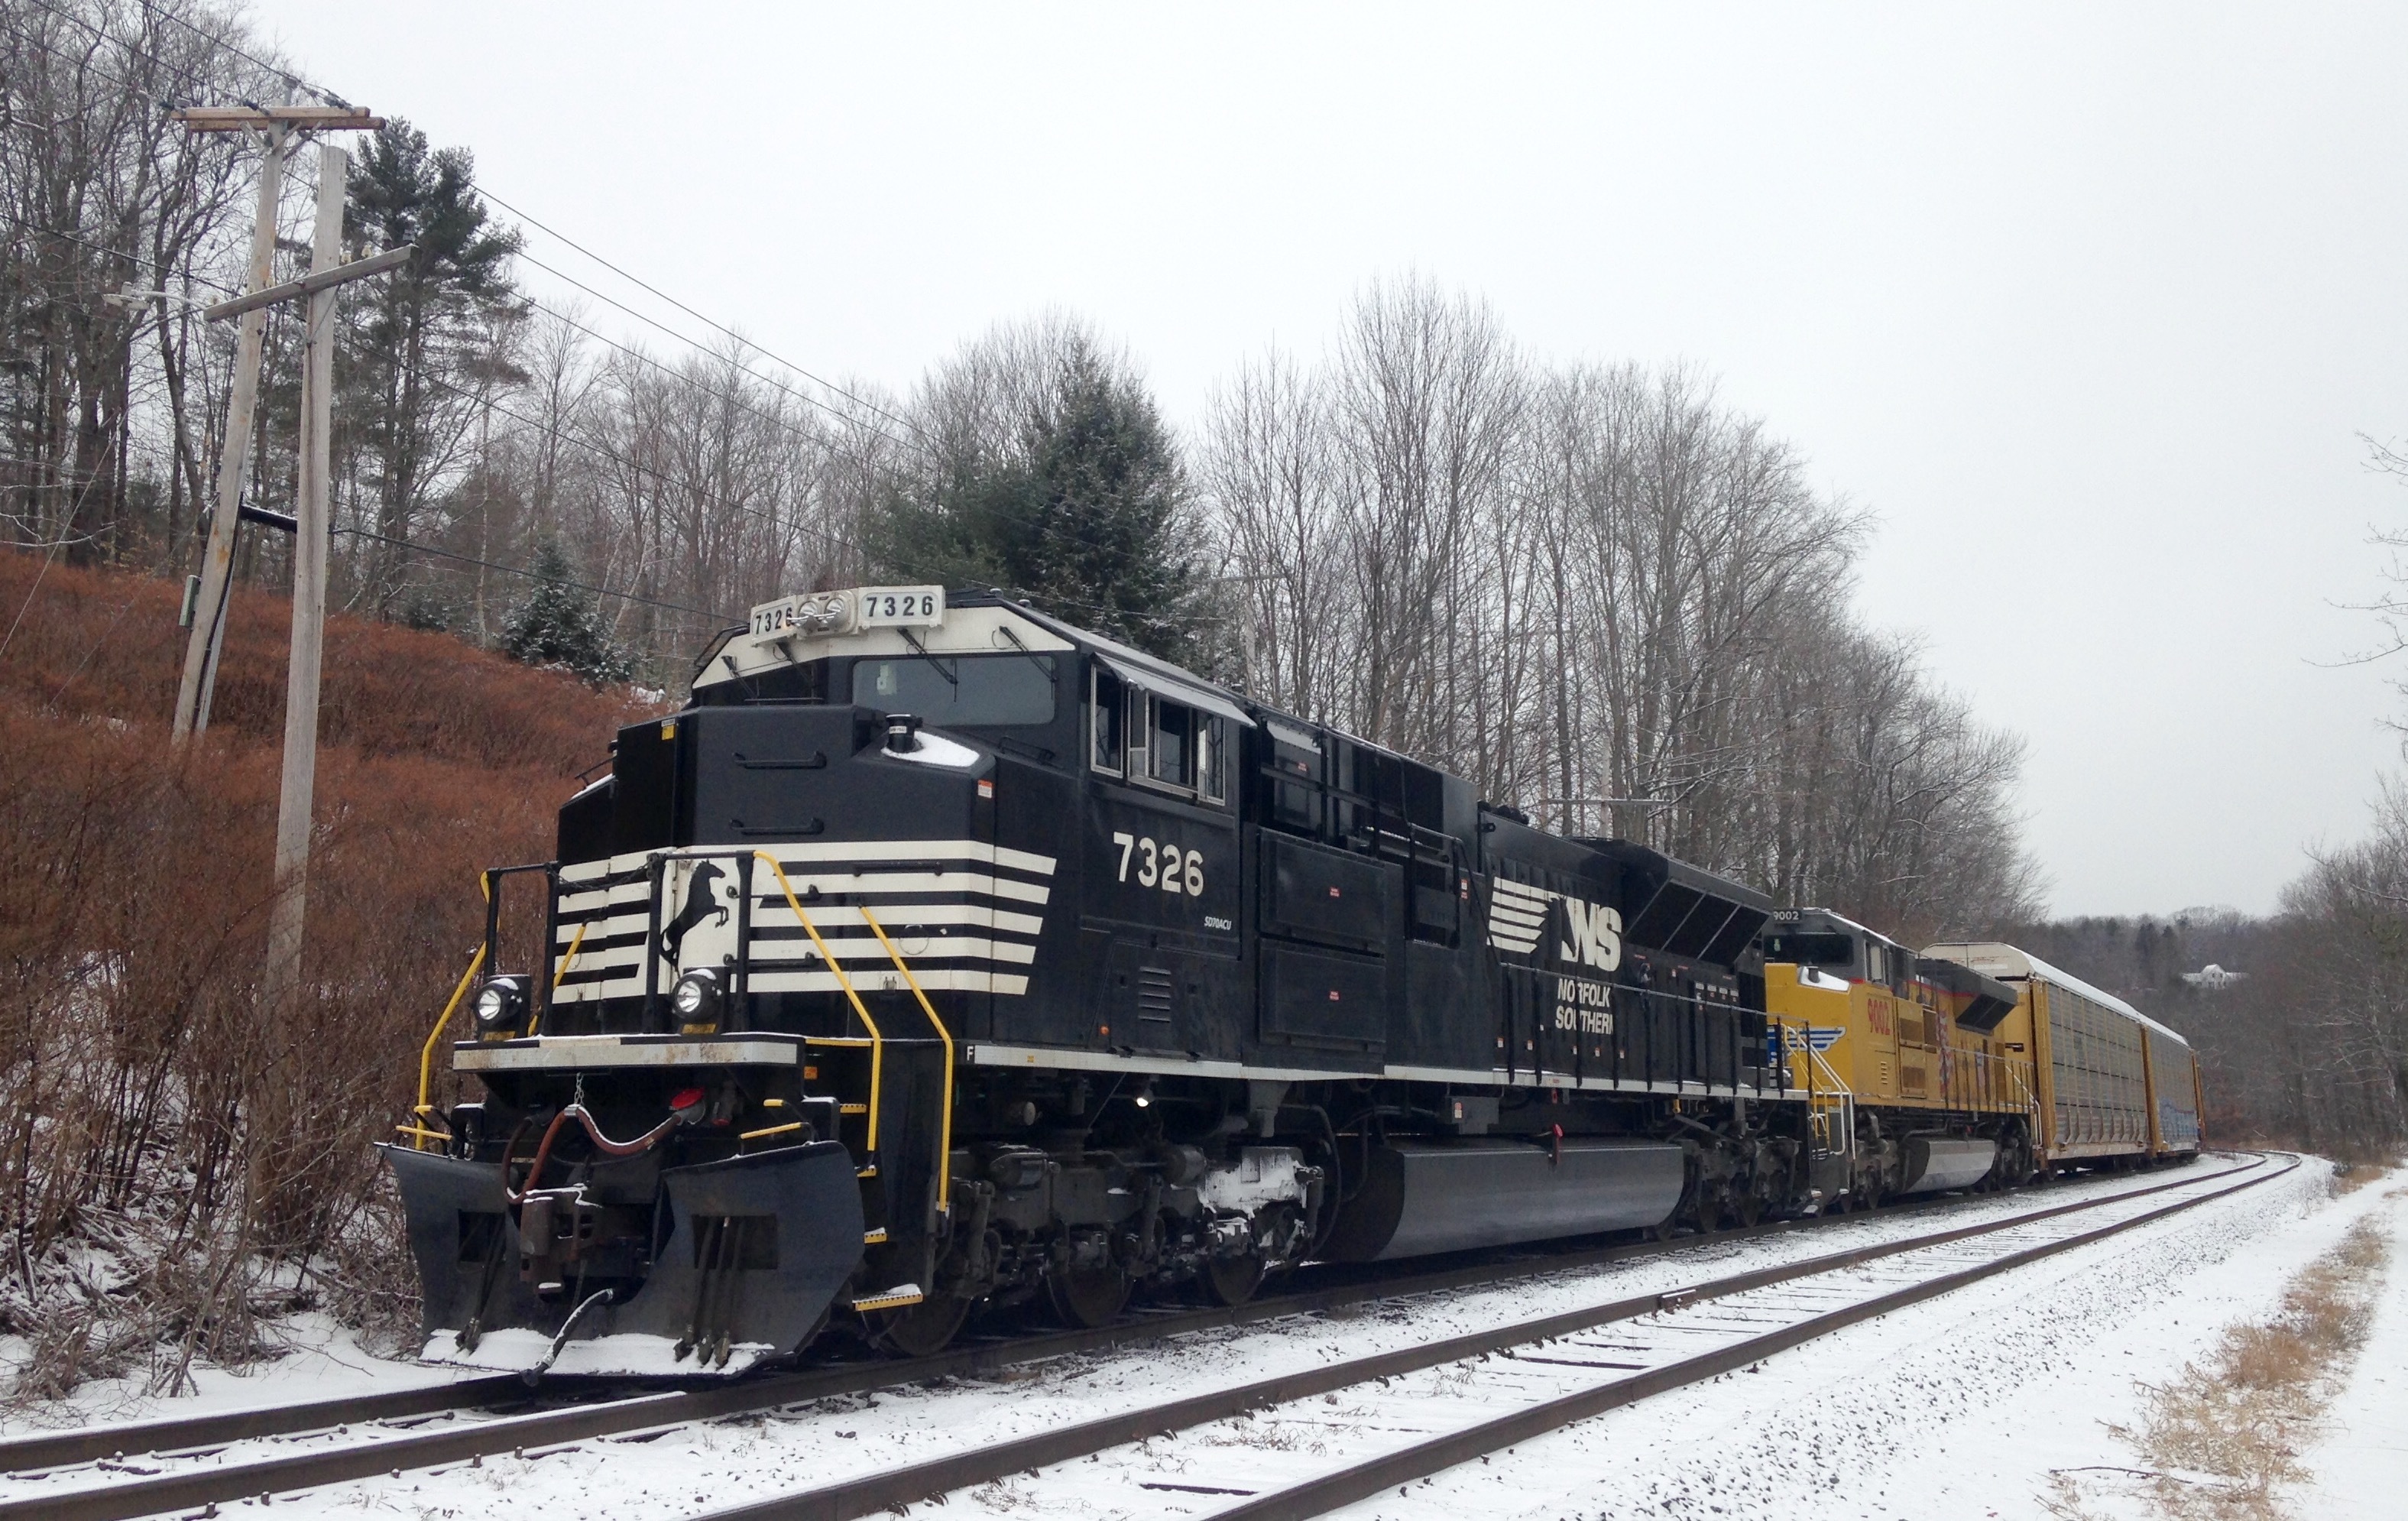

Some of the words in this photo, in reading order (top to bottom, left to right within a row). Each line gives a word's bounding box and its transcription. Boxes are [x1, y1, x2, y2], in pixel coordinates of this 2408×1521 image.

[866, 595, 934, 618] 7326
[756, 608, 793, 634] 7326
[1113, 831, 1204, 897] 7326
[1773, 911, 1800, 920] 9002
[1561, 896, 1622, 971] NS
[1867, 998, 1891, 1036] 9002
[967, 1046, 974, 1061] F
